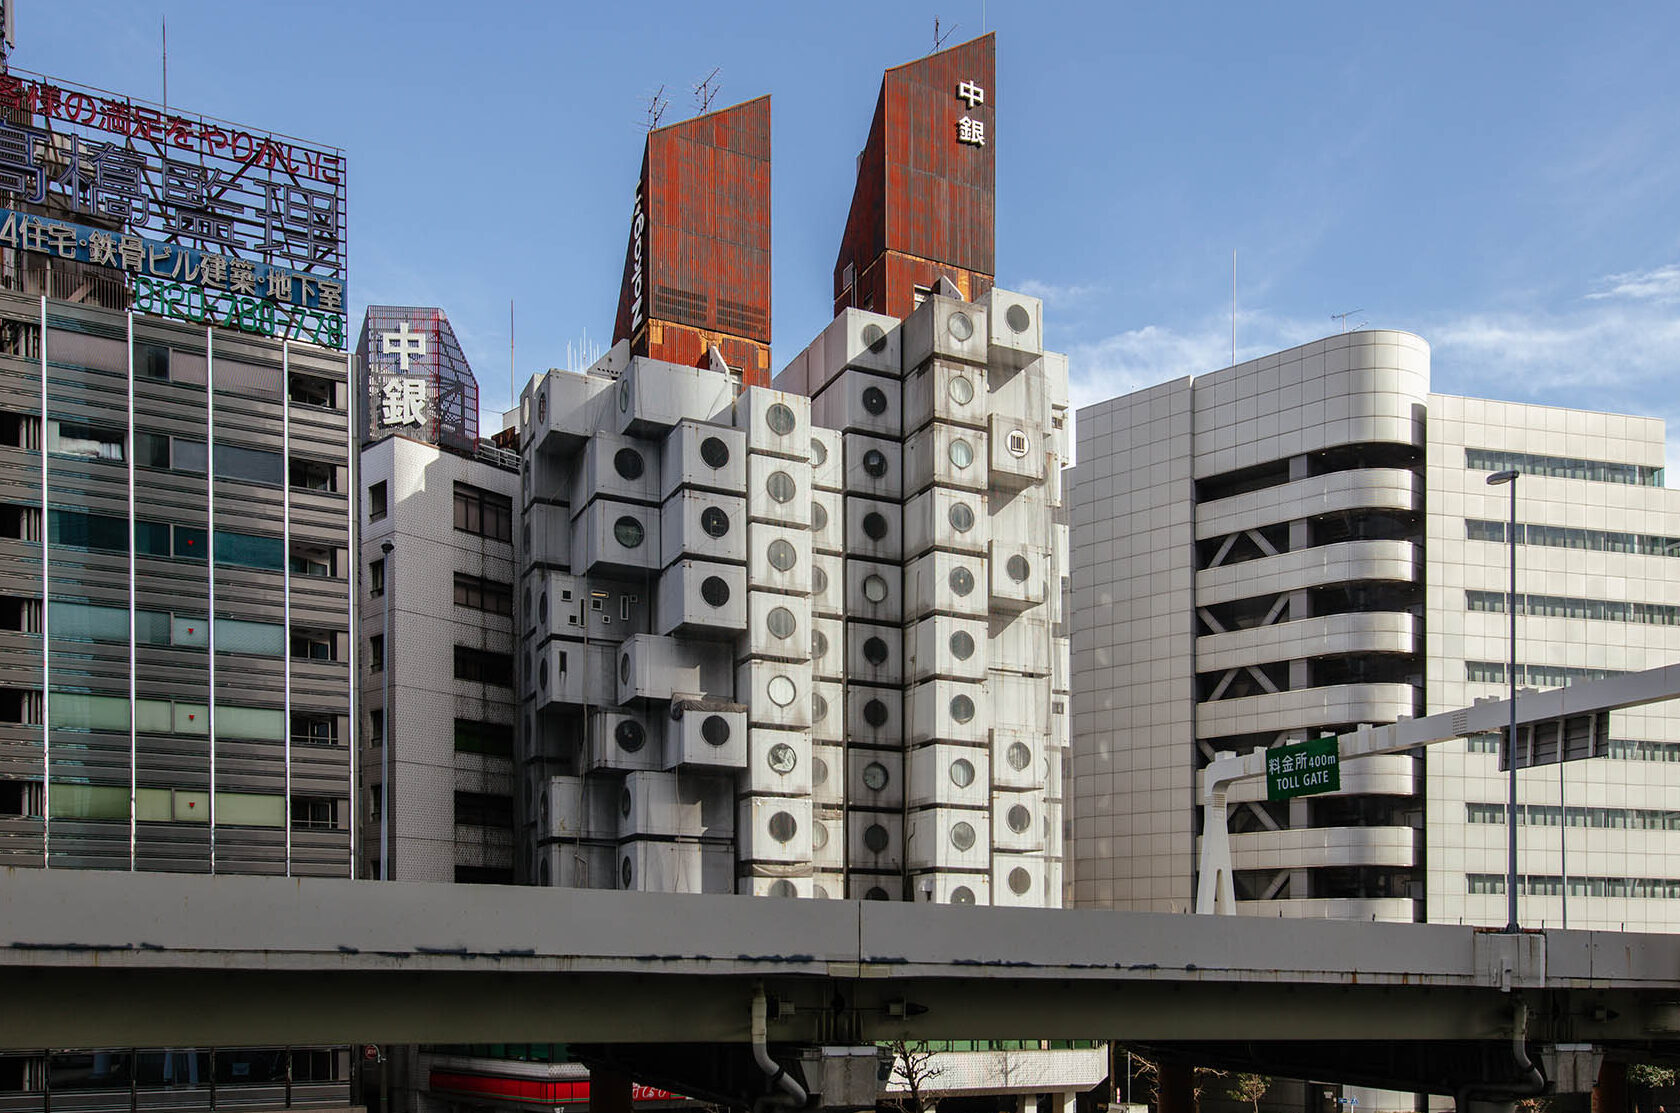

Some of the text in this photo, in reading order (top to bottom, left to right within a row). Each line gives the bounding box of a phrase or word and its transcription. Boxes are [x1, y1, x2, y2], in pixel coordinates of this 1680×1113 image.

[958, 80, 986, 146] 中銀
[135, 276, 344, 348] 0120-789-778
[382, 321, 428, 426] 中銀
[1276, 770, 1329, 791] TOLL GATE
